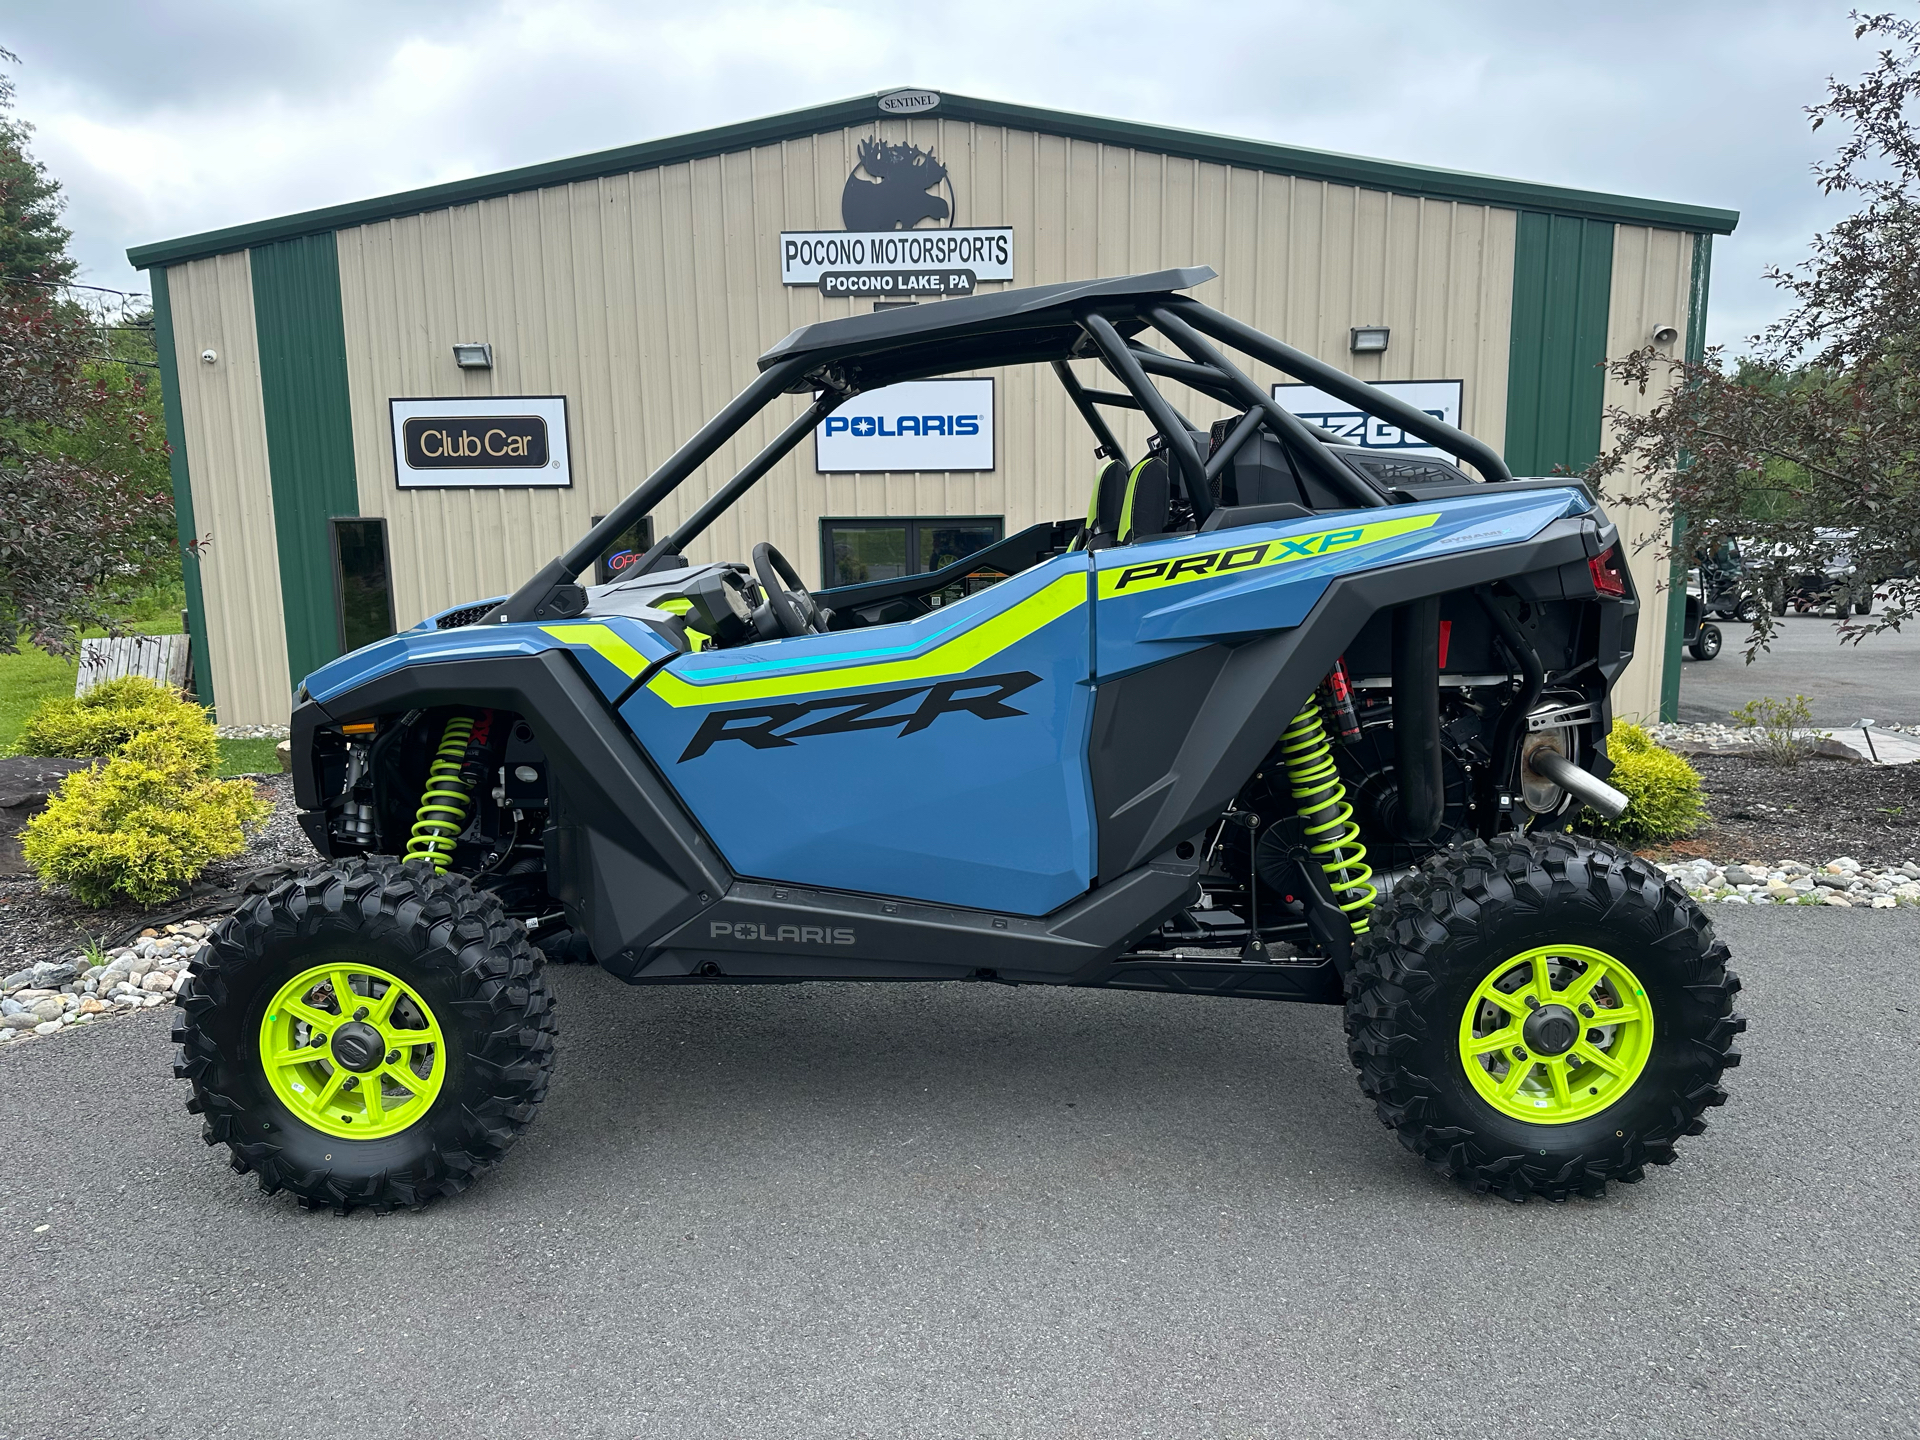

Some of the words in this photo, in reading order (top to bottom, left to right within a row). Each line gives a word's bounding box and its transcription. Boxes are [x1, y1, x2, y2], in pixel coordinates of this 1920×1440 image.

[884, 95, 934, 109] SENTINEL
[785, 239, 865, 272] POCONO
[870, 235, 1008, 266] MOTORSPORTS
[826, 277, 893, 291] POCONO
[898, 276, 945, 292] LAKE,
[949, 275, 970, 289] PA
[825, 415, 980, 437] POLARIS
[420, 430, 481, 457] Club
[484, 429, 532, 456] Car
[676, 671, 1043, 764] RZR
[710, 920, 857, 945] POLARIS
